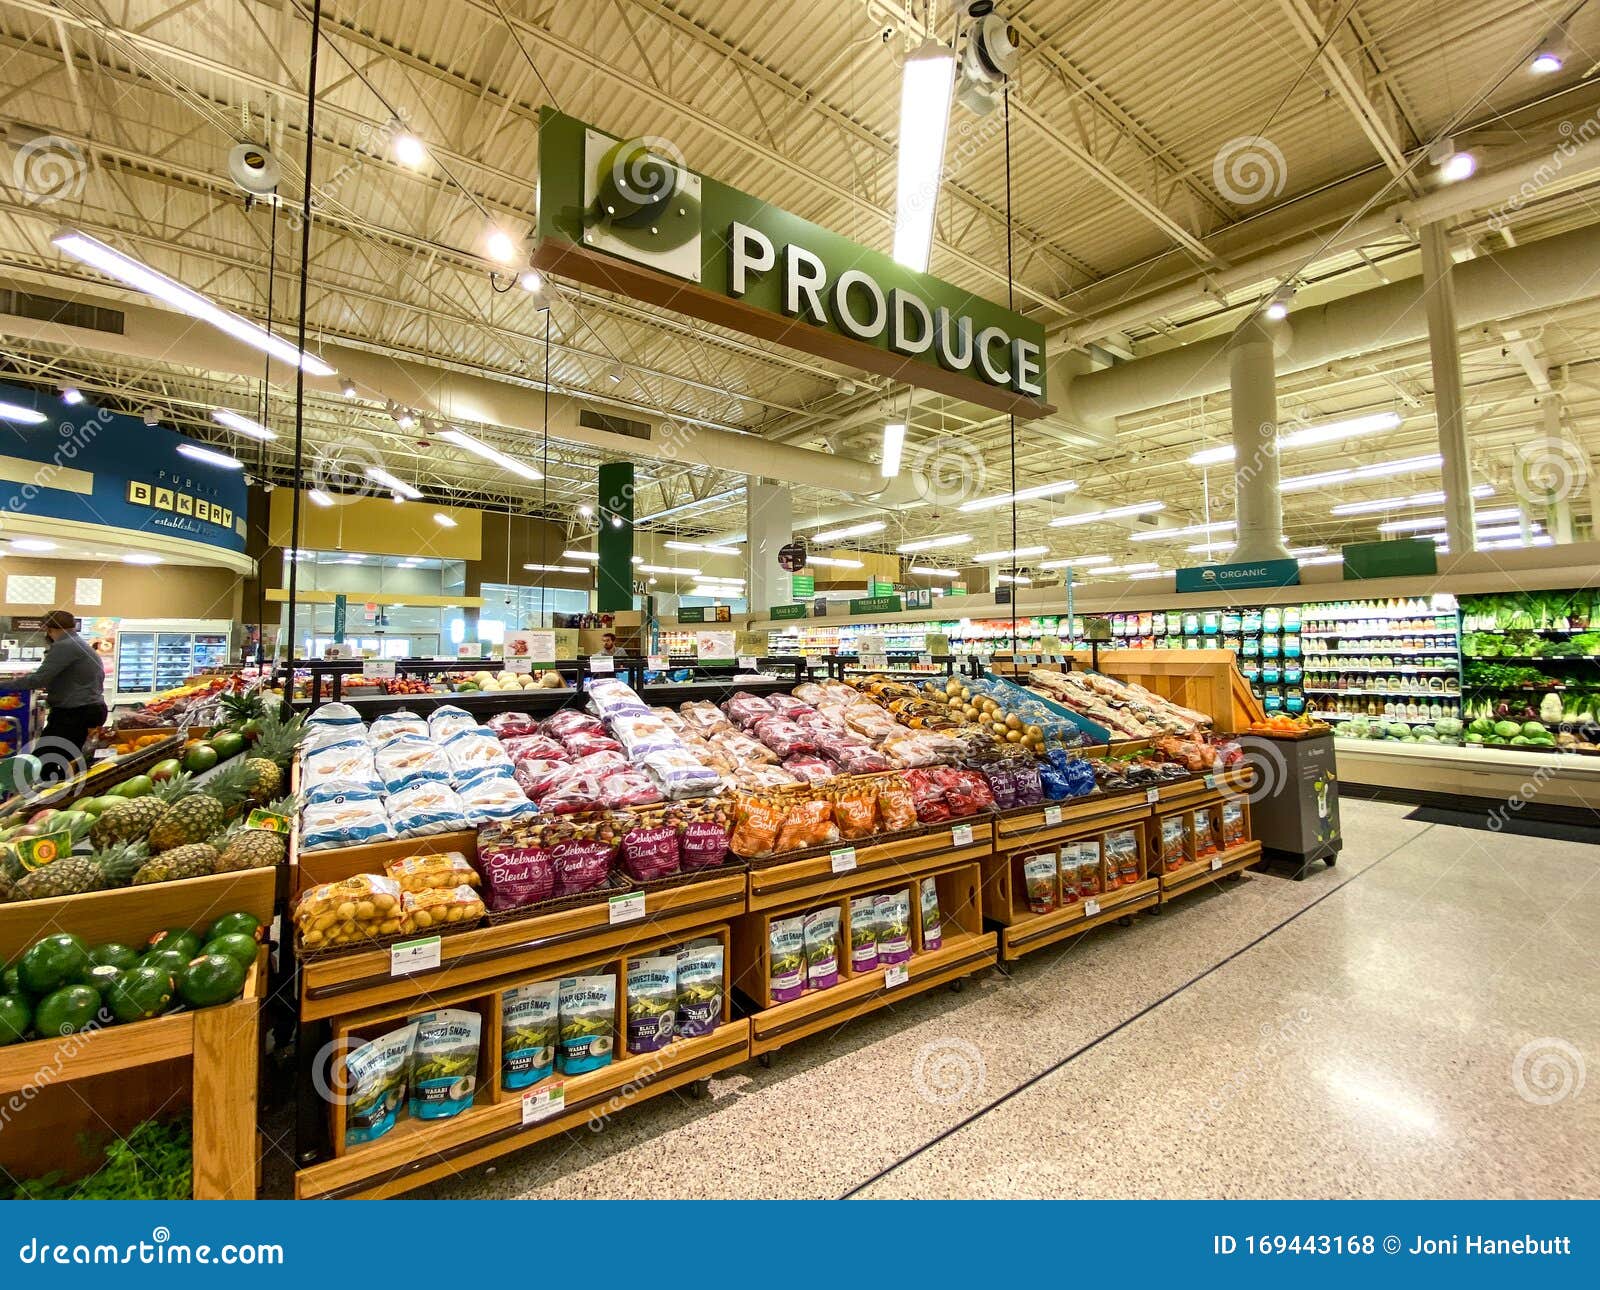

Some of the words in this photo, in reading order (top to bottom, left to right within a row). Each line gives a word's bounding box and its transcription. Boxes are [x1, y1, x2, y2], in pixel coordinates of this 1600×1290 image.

[727, 220, 1042, 398] PRODUCE
[159, 470, 218, 496] PUBLIX
[134, 486, 232, 524] BAKERY
[1219, 568, 1268, 580] ORGANIC
[749, 815, 778, 832] Gold
[492, 867, 529, 884] Blend
[509, 1056, 533, 1066] WASABI
[512, 1062, 530, 1071] RANCH
